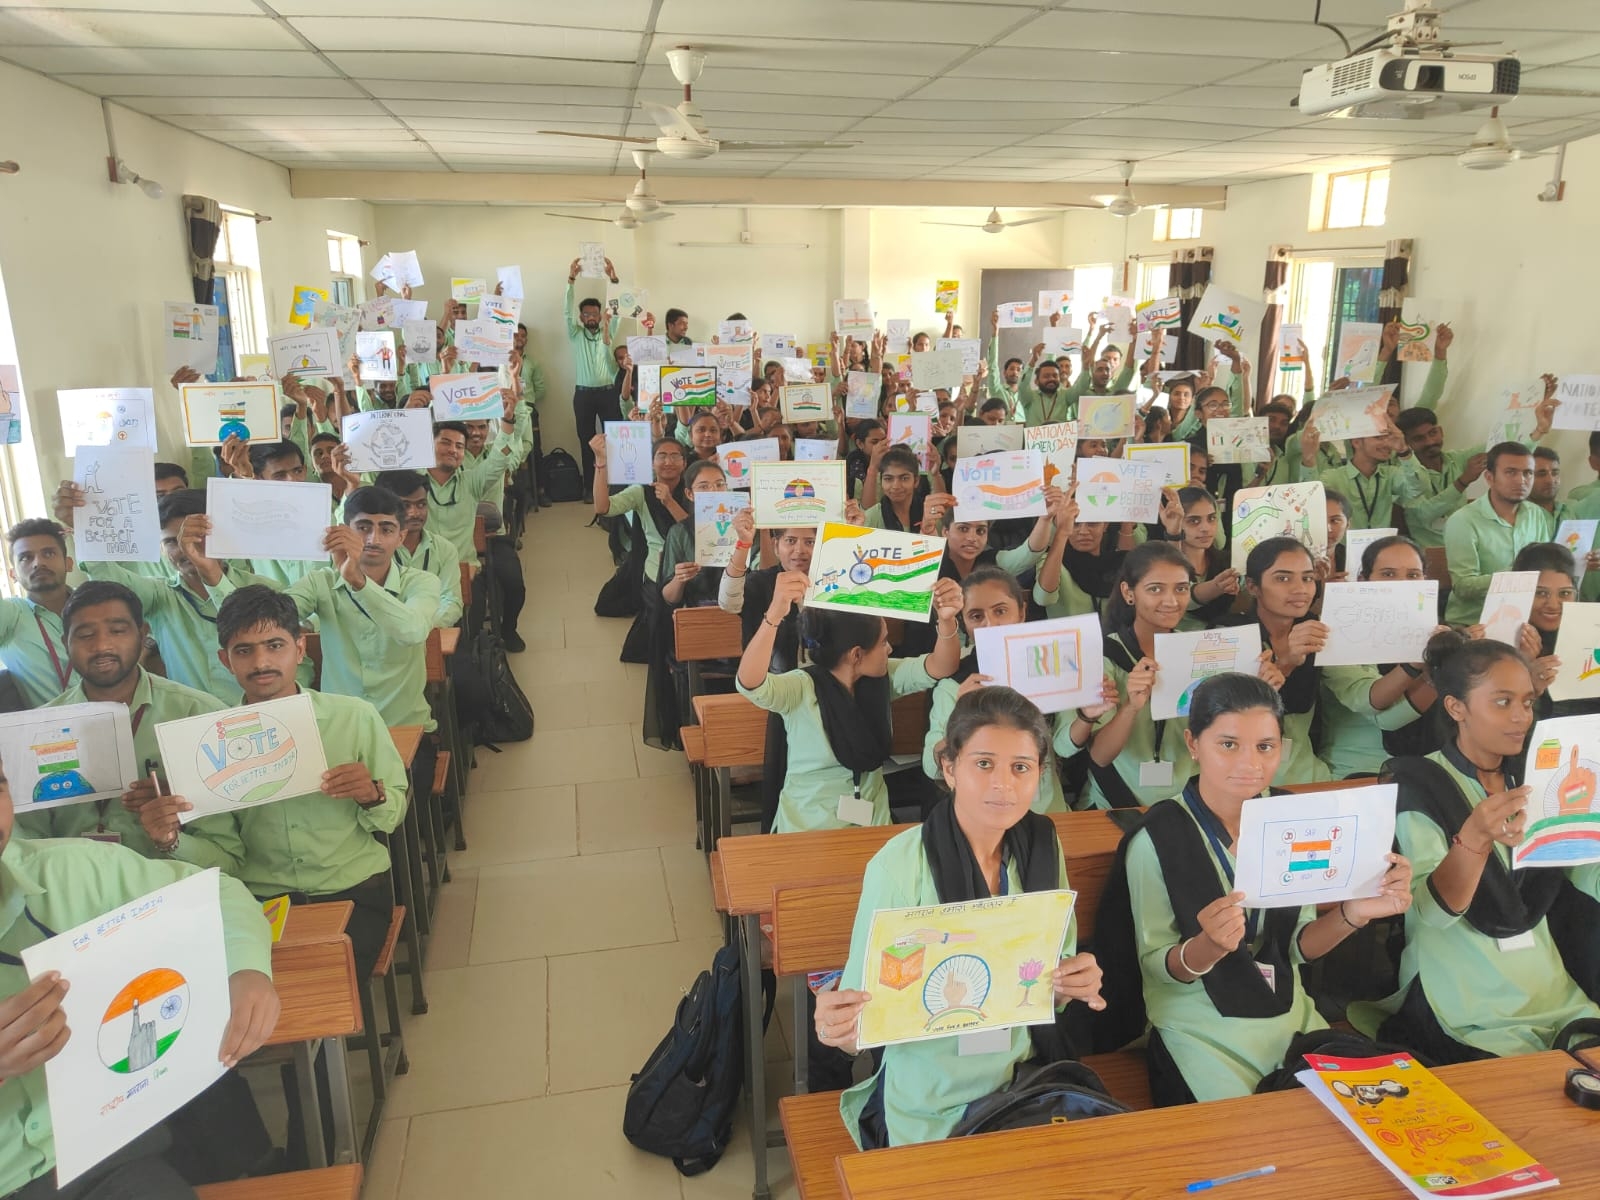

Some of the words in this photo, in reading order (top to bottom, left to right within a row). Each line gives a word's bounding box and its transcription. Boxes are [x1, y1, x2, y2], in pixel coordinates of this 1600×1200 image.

[1458, 73, 1477, 81] EPSON
[485, 300, 504, 309] VOTE
[1143, 306, 1170, 322] VOTE
[716, 360, 742, 370] VOTE
[670, 376, 693, 390] VOTE
[1561, 381, 1600, 398] NATIO
[442, 386, 478, 405] VOTE
[607, 425, 648, 440] VOTE
[1026, 422, 1077, 441] NATIONAL
[1056, 437, 1076, 451] DAY
[960, 465, 1001, 483] VOTE
[1119, 463, 1151, 479] VOTE
[92, 493, 143, 517] VOTE
[1120, 492, 1156, 507] BETTER
[123, 516, 134, 529] A
[106, 542, 140, 555] INDIA
[852, 547, 903, 564] VOTE
[201, 727, 280, 772] VOTE
[223, 779, 241, 795] FOR
[72, 933, 91, 950] FOR
[96, 912, 127, 936] BETTER
[130, 895, 163, 918] INDIA
